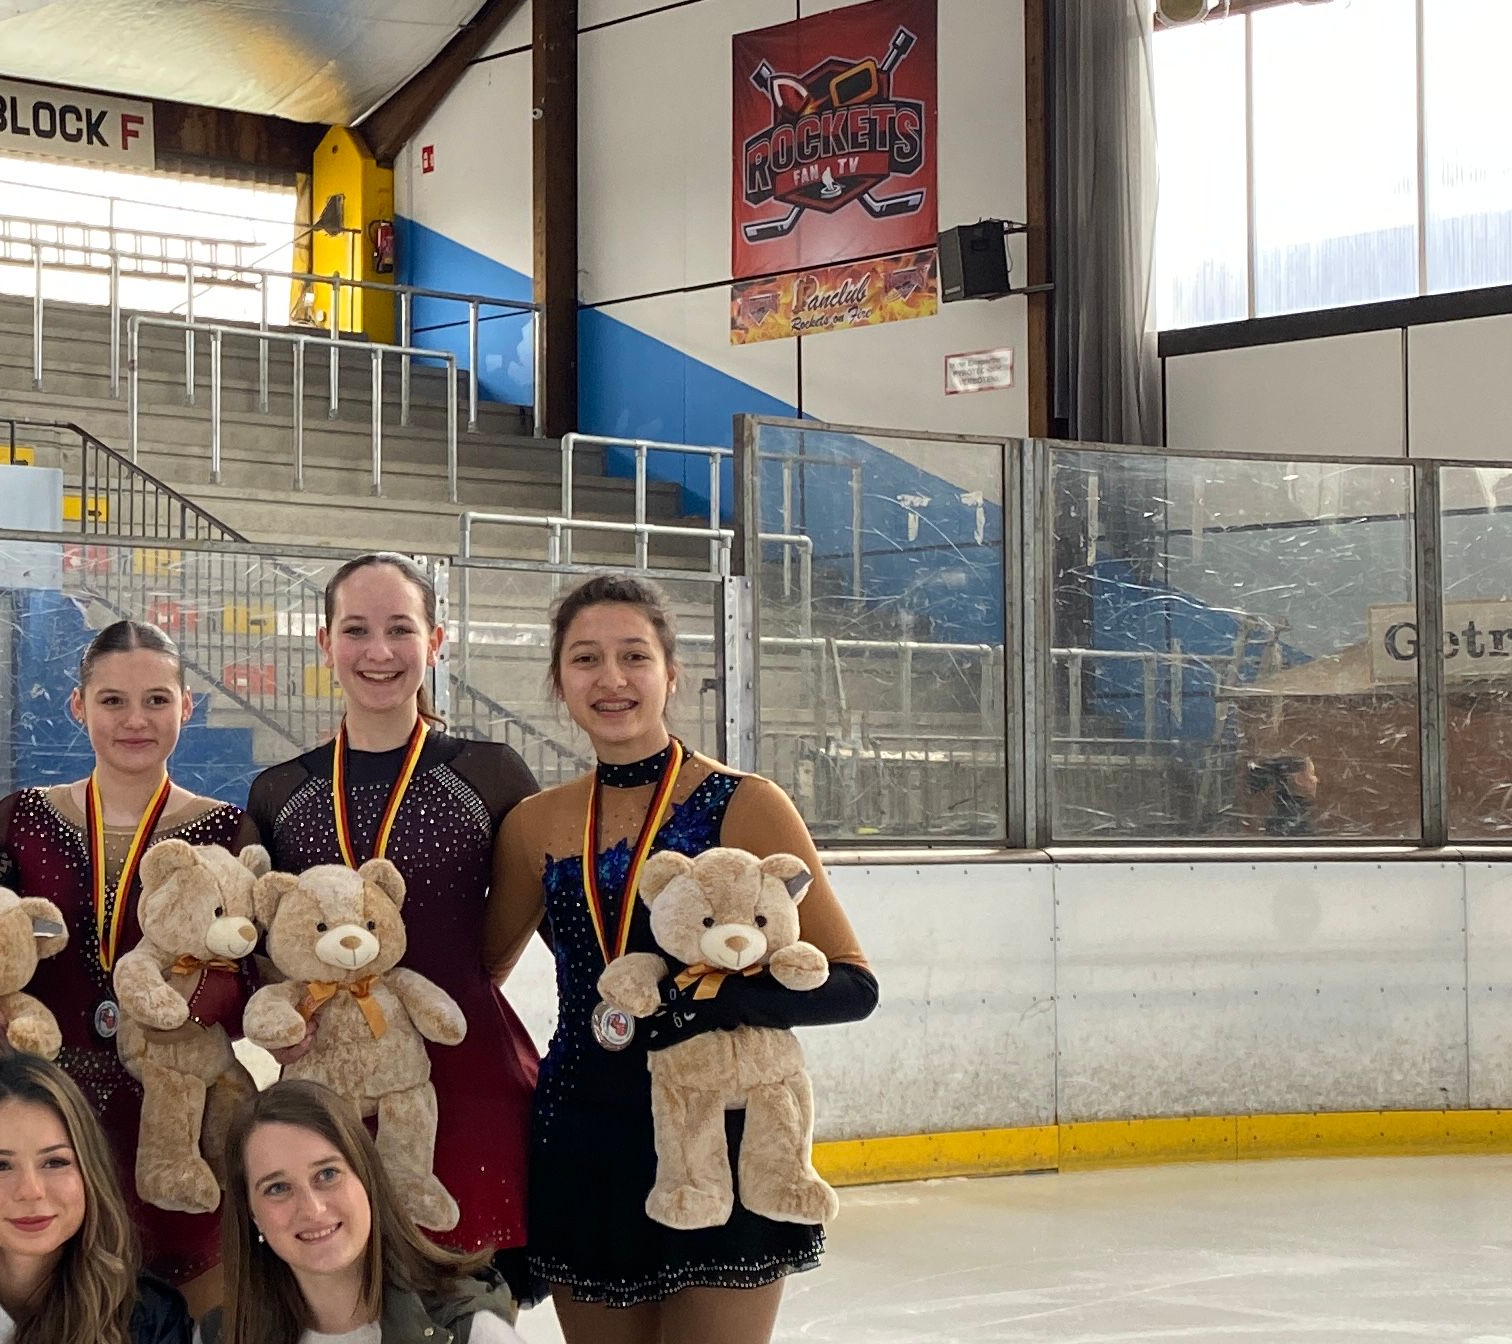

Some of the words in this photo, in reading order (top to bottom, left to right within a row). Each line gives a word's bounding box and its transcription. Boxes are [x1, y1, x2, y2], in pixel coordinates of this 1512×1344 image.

[121, 113, 144, 150] F
[746, 104, 920, 193] ROCKETS
[793, 164, 819, 185] FAN
[837, 156, 859, 174] TV
[791, 317, 829, 332] Rockets
[832, 314, 845, 324] on
[848, 306, 872, 325] Fire
